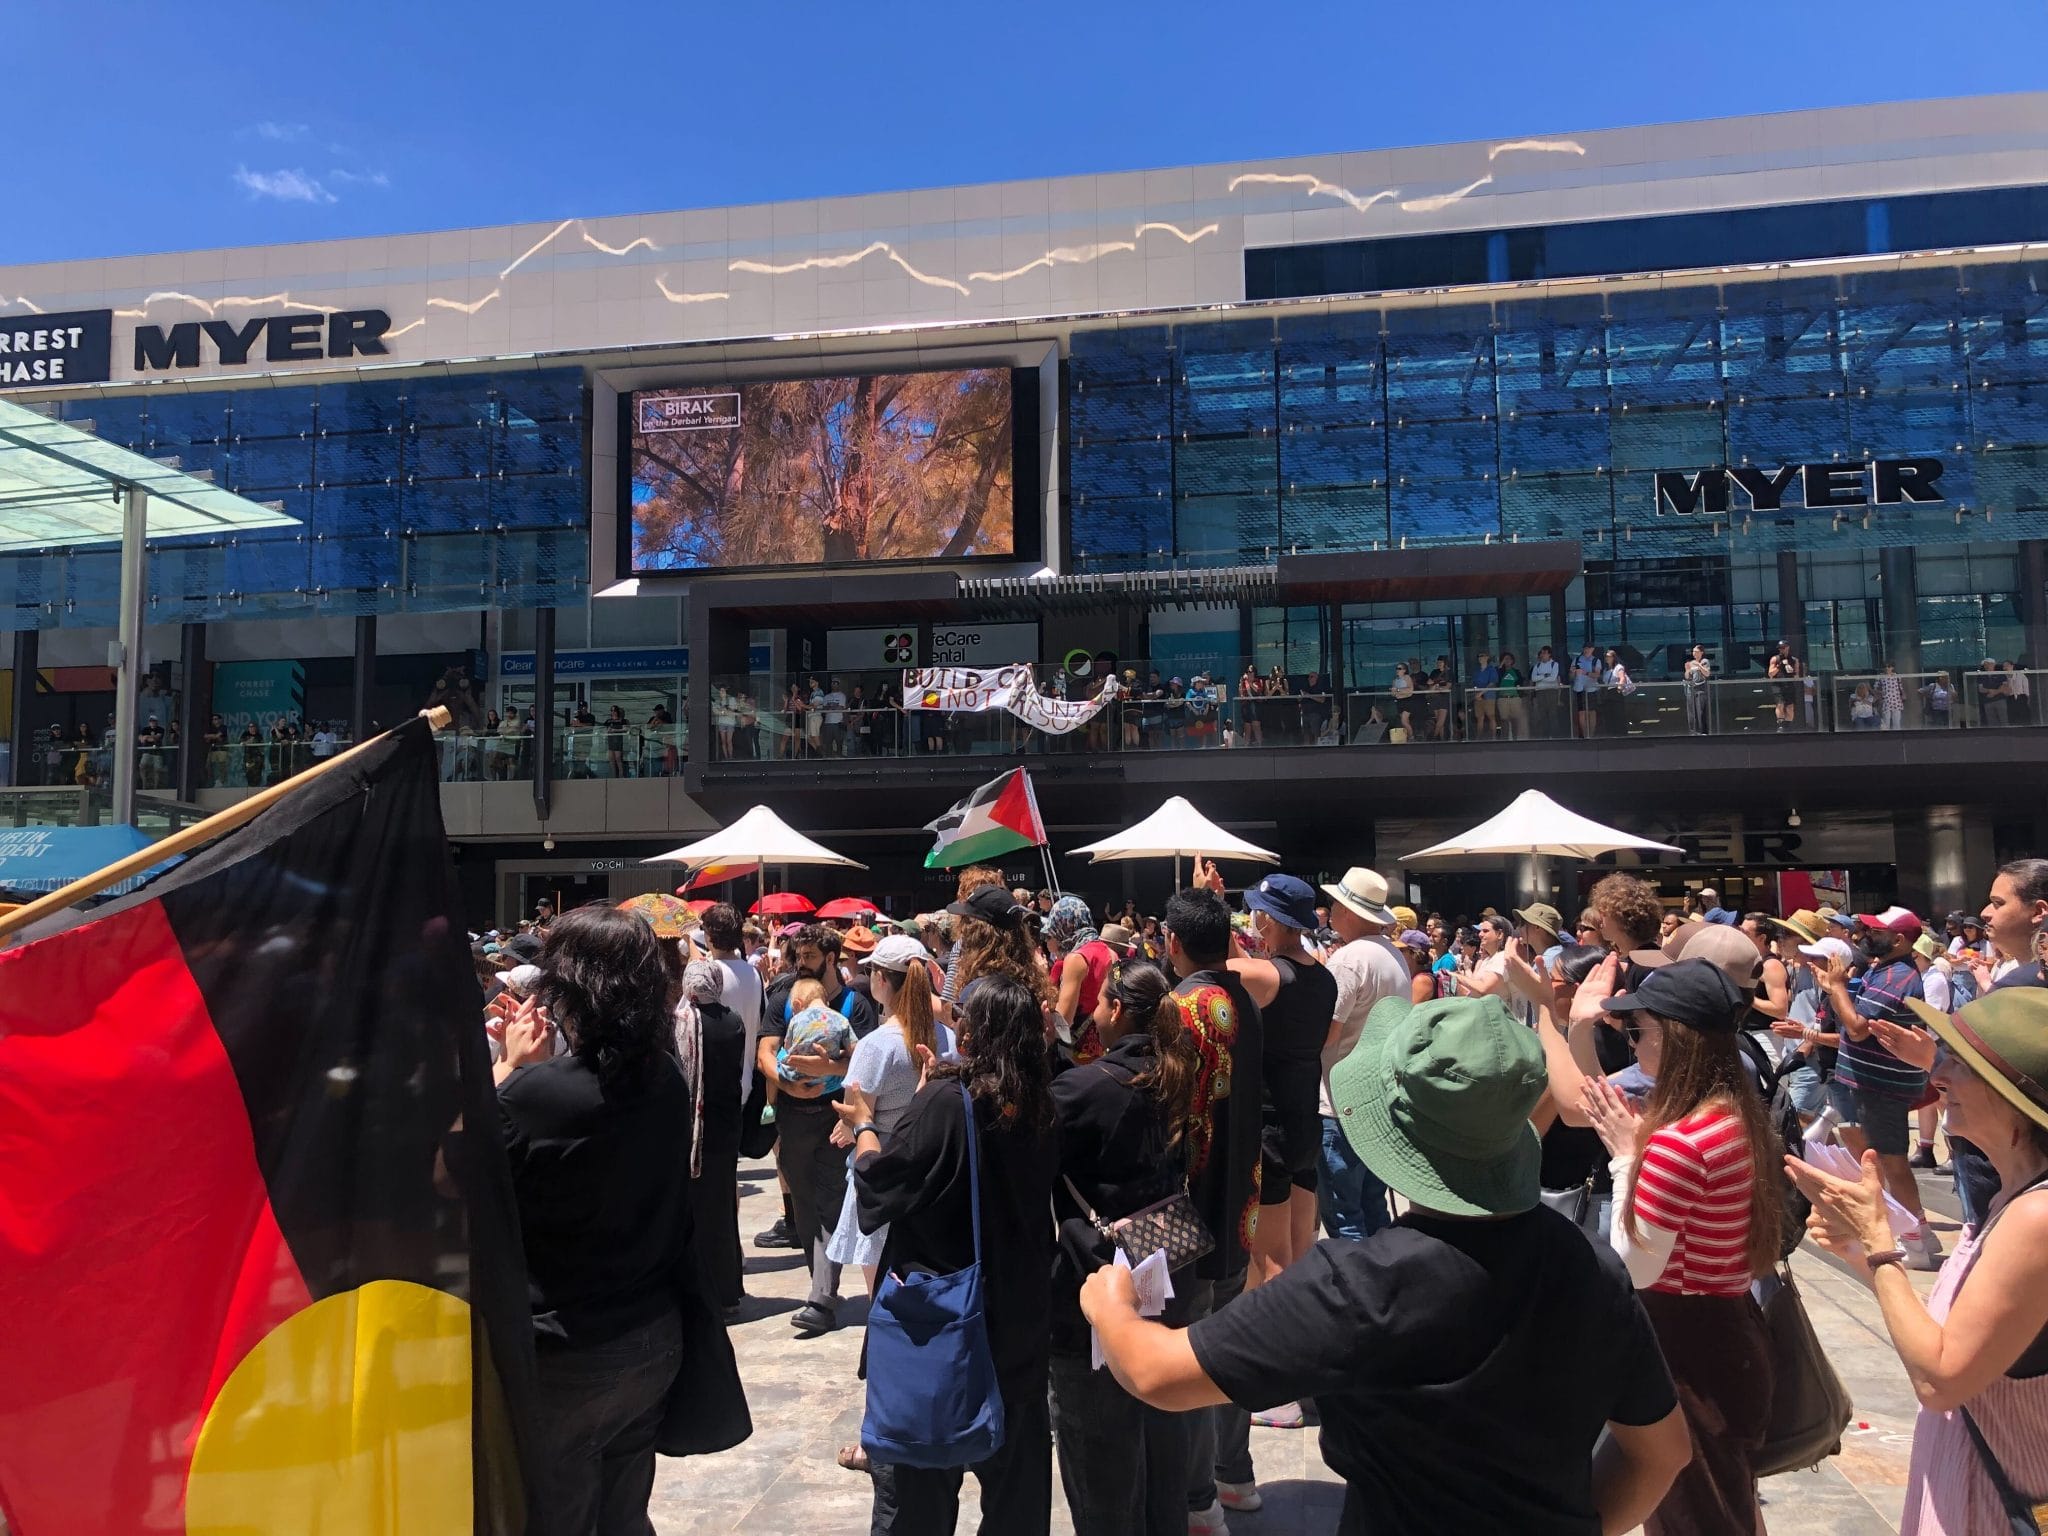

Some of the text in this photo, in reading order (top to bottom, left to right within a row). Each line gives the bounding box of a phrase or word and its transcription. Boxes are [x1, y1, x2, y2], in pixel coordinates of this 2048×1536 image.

[135, 309, 391, 371] MYER
[665, 400, 714, 416] BIRAK
[1655, 459, 1944, 516] MYER
[932, 631, 981, 646] feCare
[932, 648, 965, 663] ental
[504, 659, 533, 671] Clear
[554, 659, 585, 670] ncare
[904, 669, 982, 689] BUILD
[948, 688, 996, 708] NOT
[219, 711, 252, 727] IND
[1006, 873, 1025, 881] LUB
